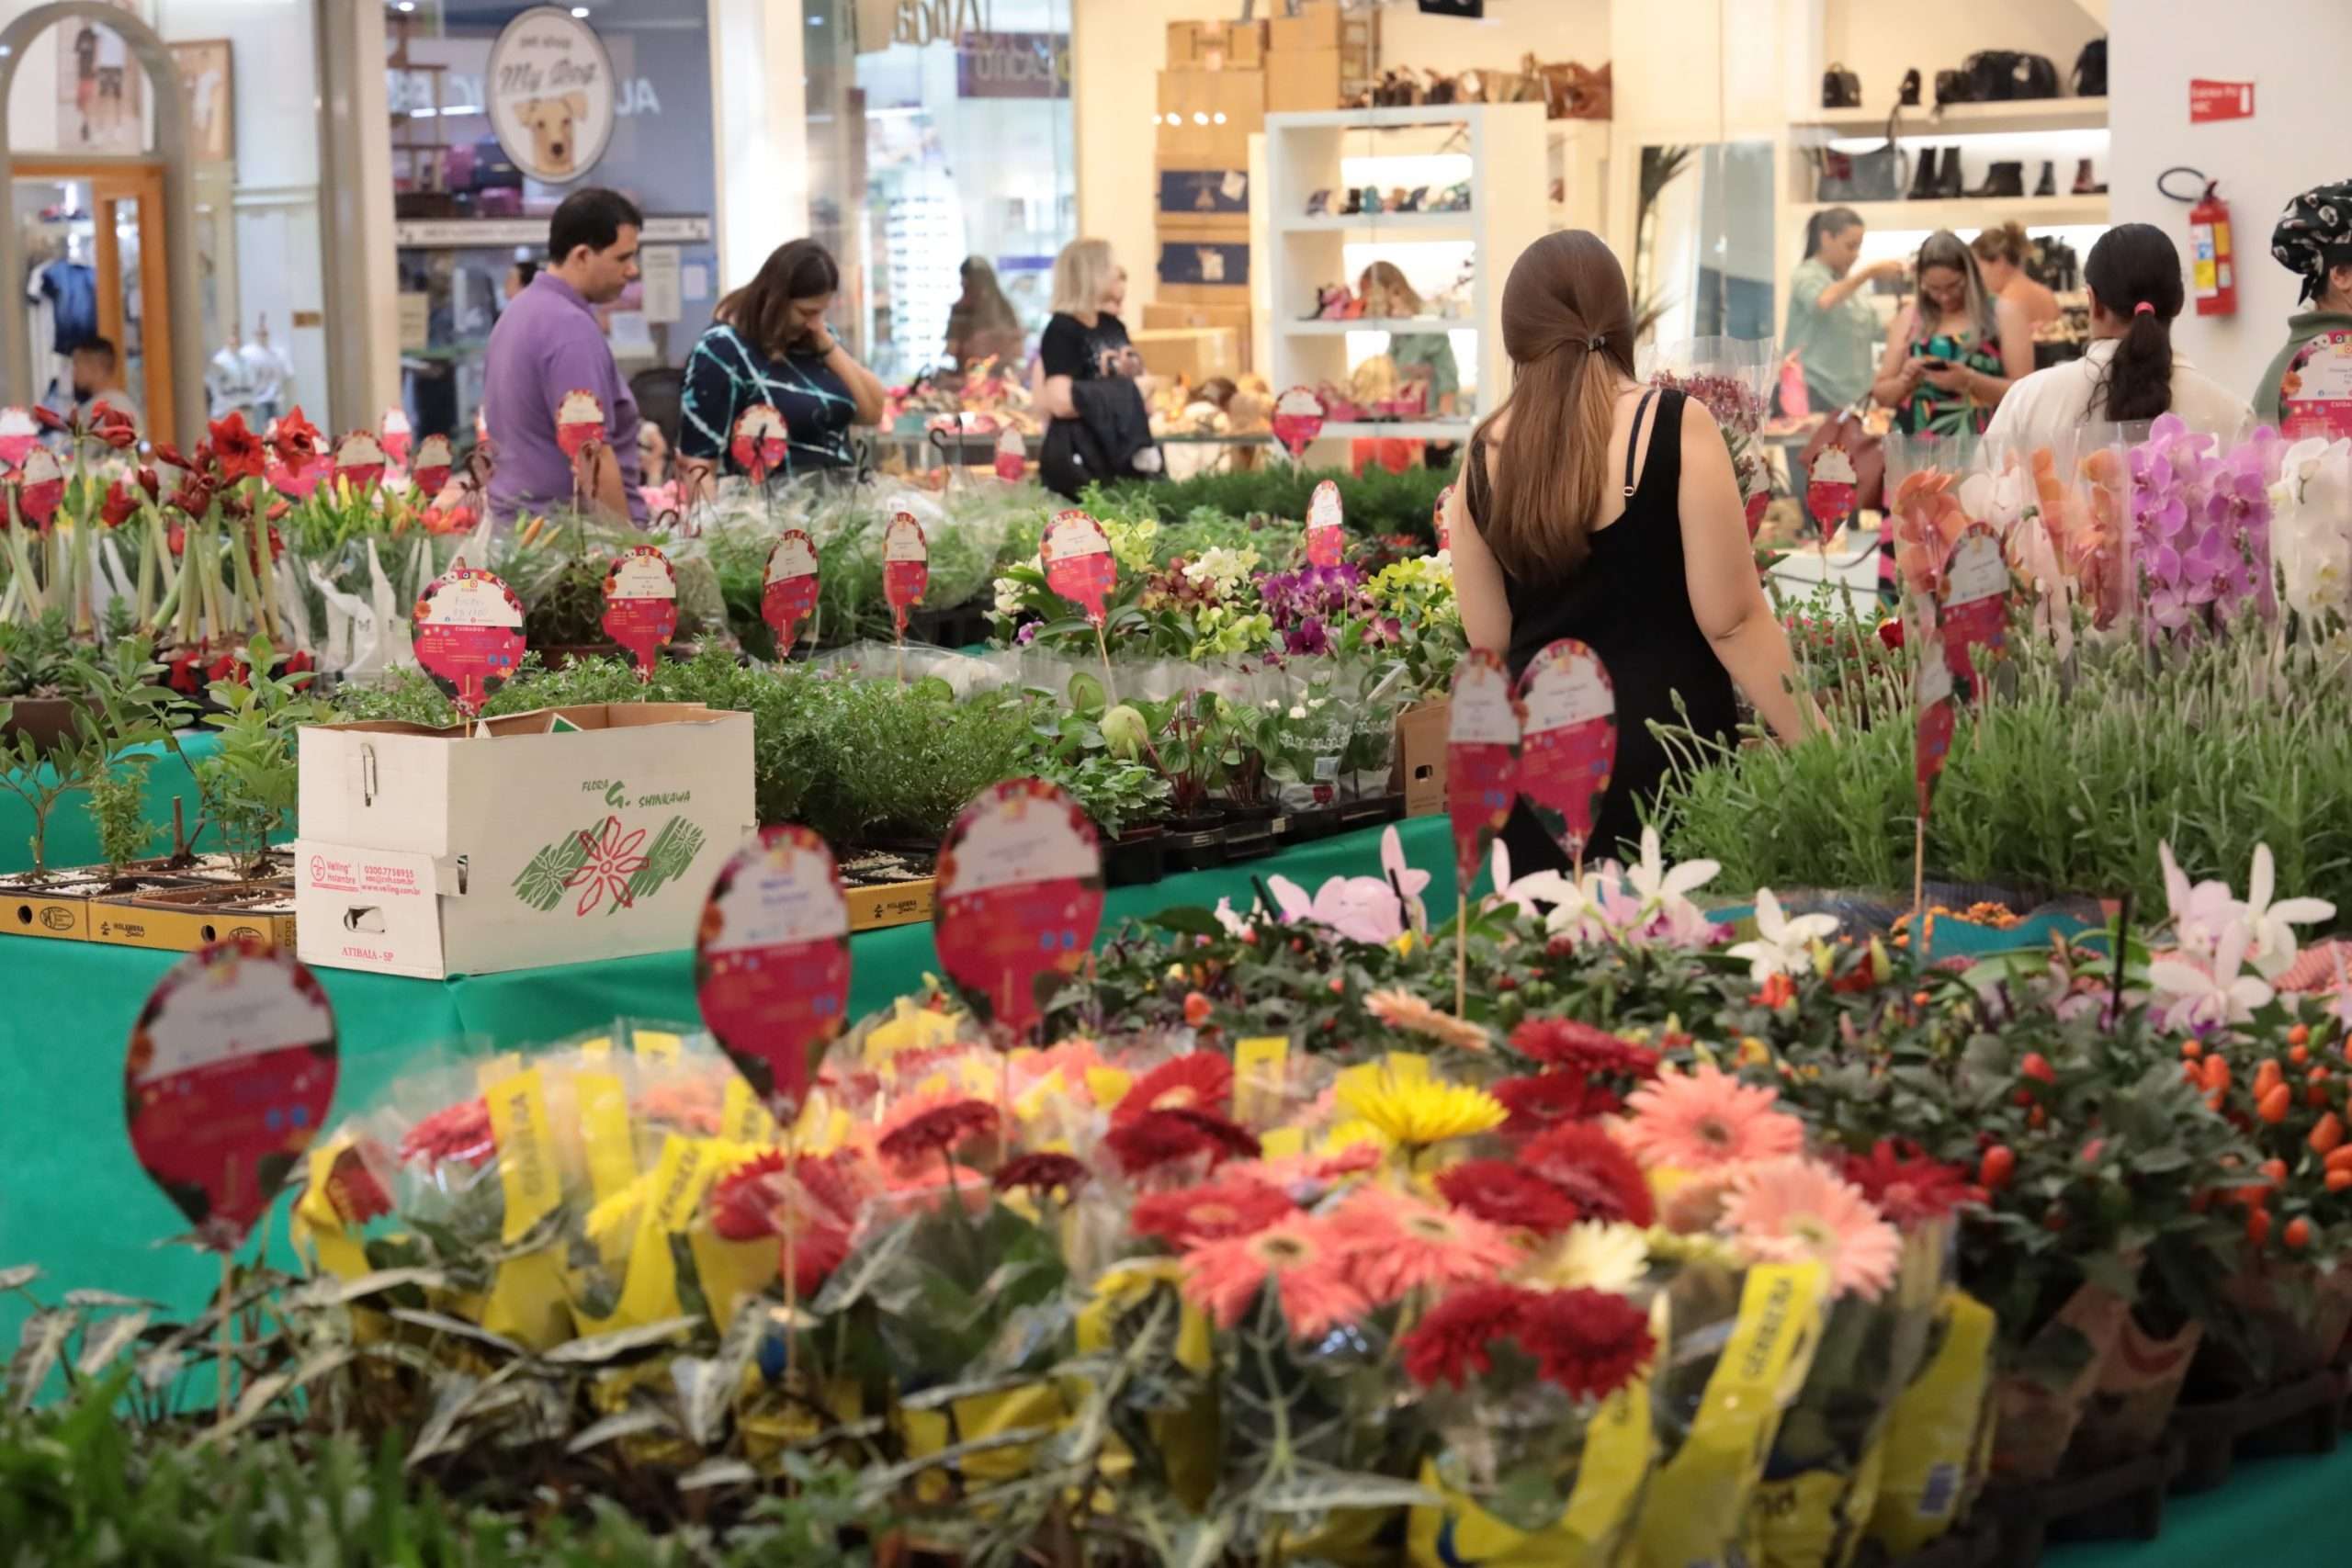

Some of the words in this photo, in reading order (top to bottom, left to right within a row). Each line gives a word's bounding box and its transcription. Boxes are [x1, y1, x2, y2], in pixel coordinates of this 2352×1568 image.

[500, 61, 544, 93] My
[582, 779, 608, 793] FLORA
[639, 790, 691, 808] SHINKAWA
[341, 946, 378, 961] ATIBAIA
